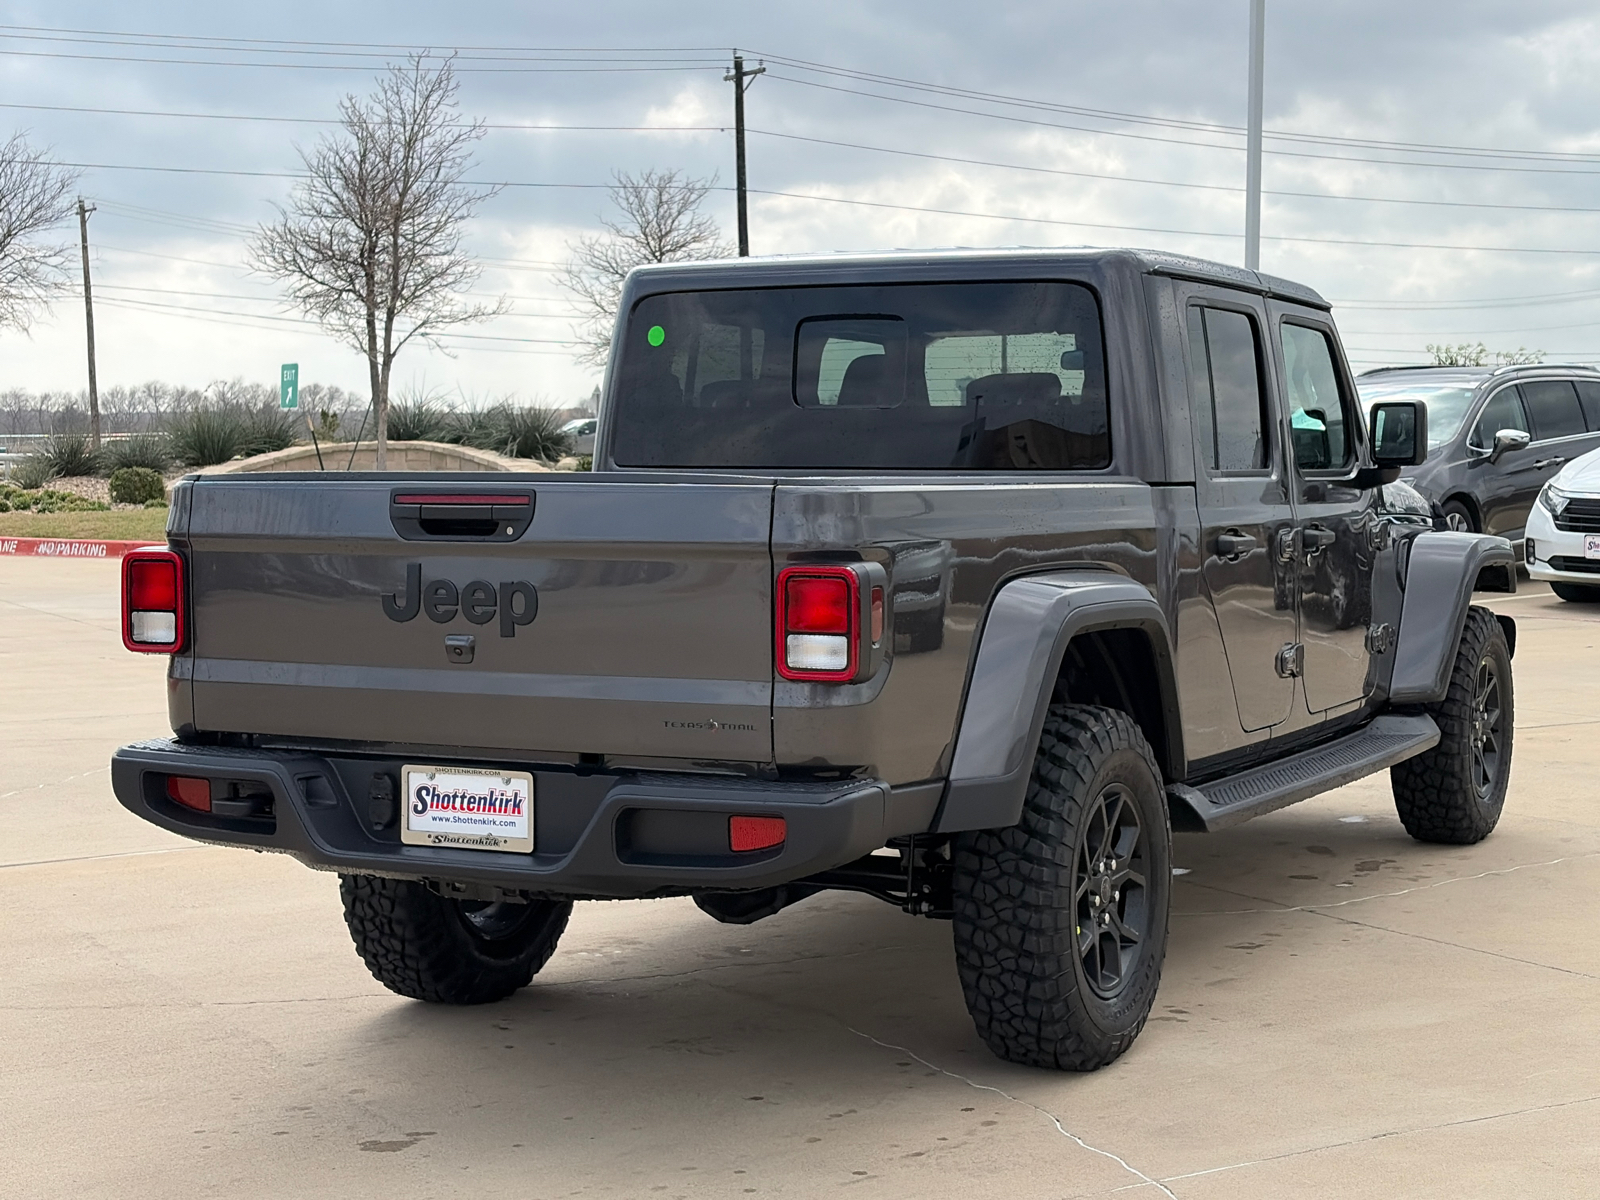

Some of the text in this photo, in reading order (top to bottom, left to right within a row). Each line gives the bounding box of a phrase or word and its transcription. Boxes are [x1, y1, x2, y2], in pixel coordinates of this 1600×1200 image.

[283, 370, 295, 381] EXIT
[38, 541, 55, 554] NO
[56, 542, 107, 557] PARKING
[381, 562, 539, 638] Jeep
[663, 721, 757, 731] TEXAS TRAIL
[434, 767, 501, 776] SHOTTENKIRK.COM
[413, 785, 523, 815] Shottenkirk
[431, 815, 516, 828] www.Shottenkirk.com
